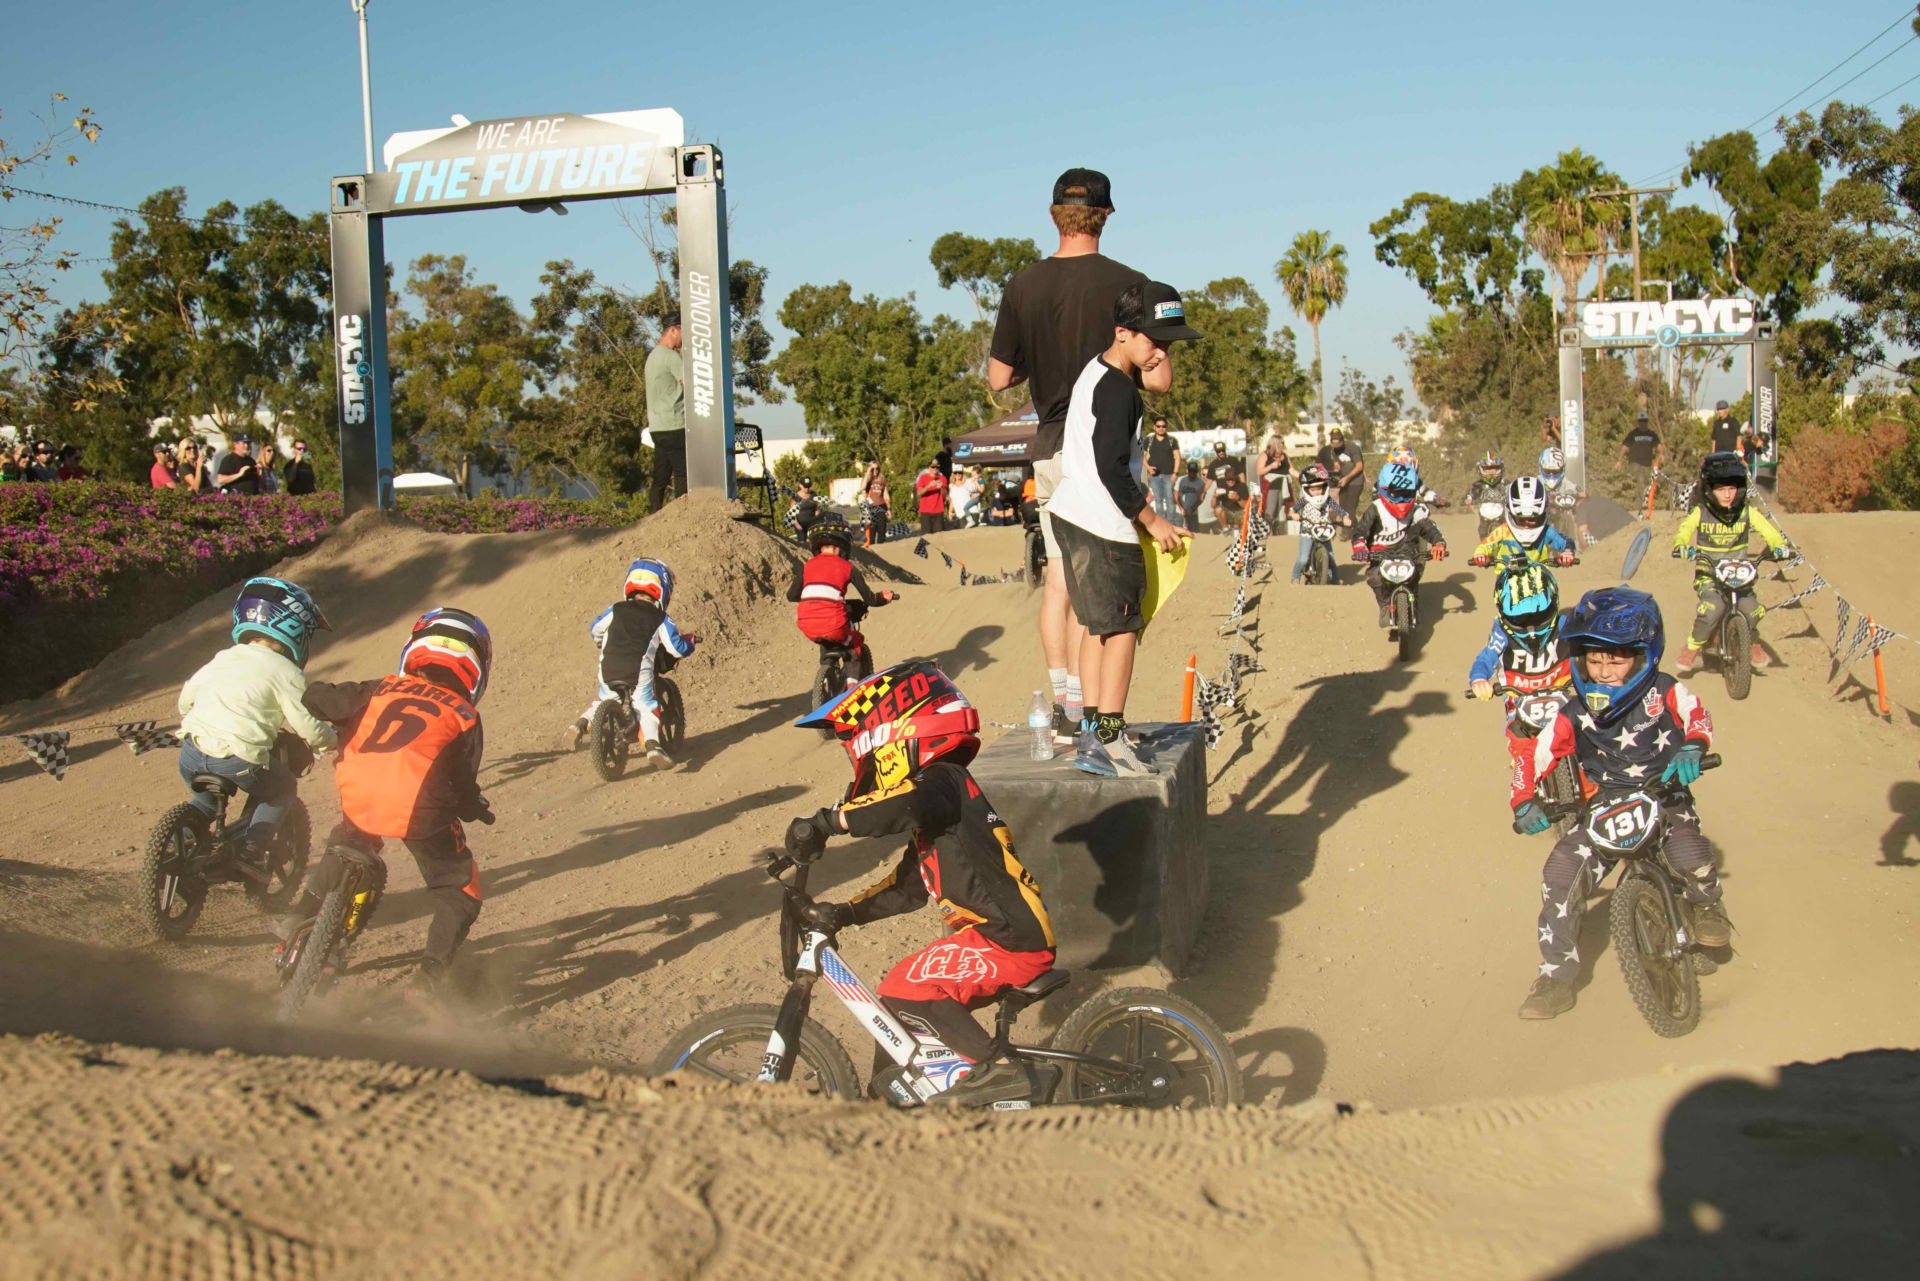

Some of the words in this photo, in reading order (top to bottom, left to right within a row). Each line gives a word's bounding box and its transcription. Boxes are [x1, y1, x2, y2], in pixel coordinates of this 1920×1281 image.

[476, 122, 515, 150] WE
[515, 118, 565, 146] ARE
[394, 156, 476, 204] THE
[479, 141, 651, 196] FUTURE
[1583, 298, 1753, 337] STACYC
[689, 271, 715, 418] #RIDESOONER
[340, 314, 365, 424] STACYC
[1563, 400, 1578, 458] STACYC
[1701, 522, 1714, 534] FLY
[1511, 638, 1560, 673] FOX
[358, 697, 442, 754] 6
[1530, 701, 1560, 720] 52
[852, 717, 917, 760] 100%
[881, 751, 897, 763] FOX
[1604, 805, 1646, 841] 131
[872, 1014, 903, 1048] STACYC
